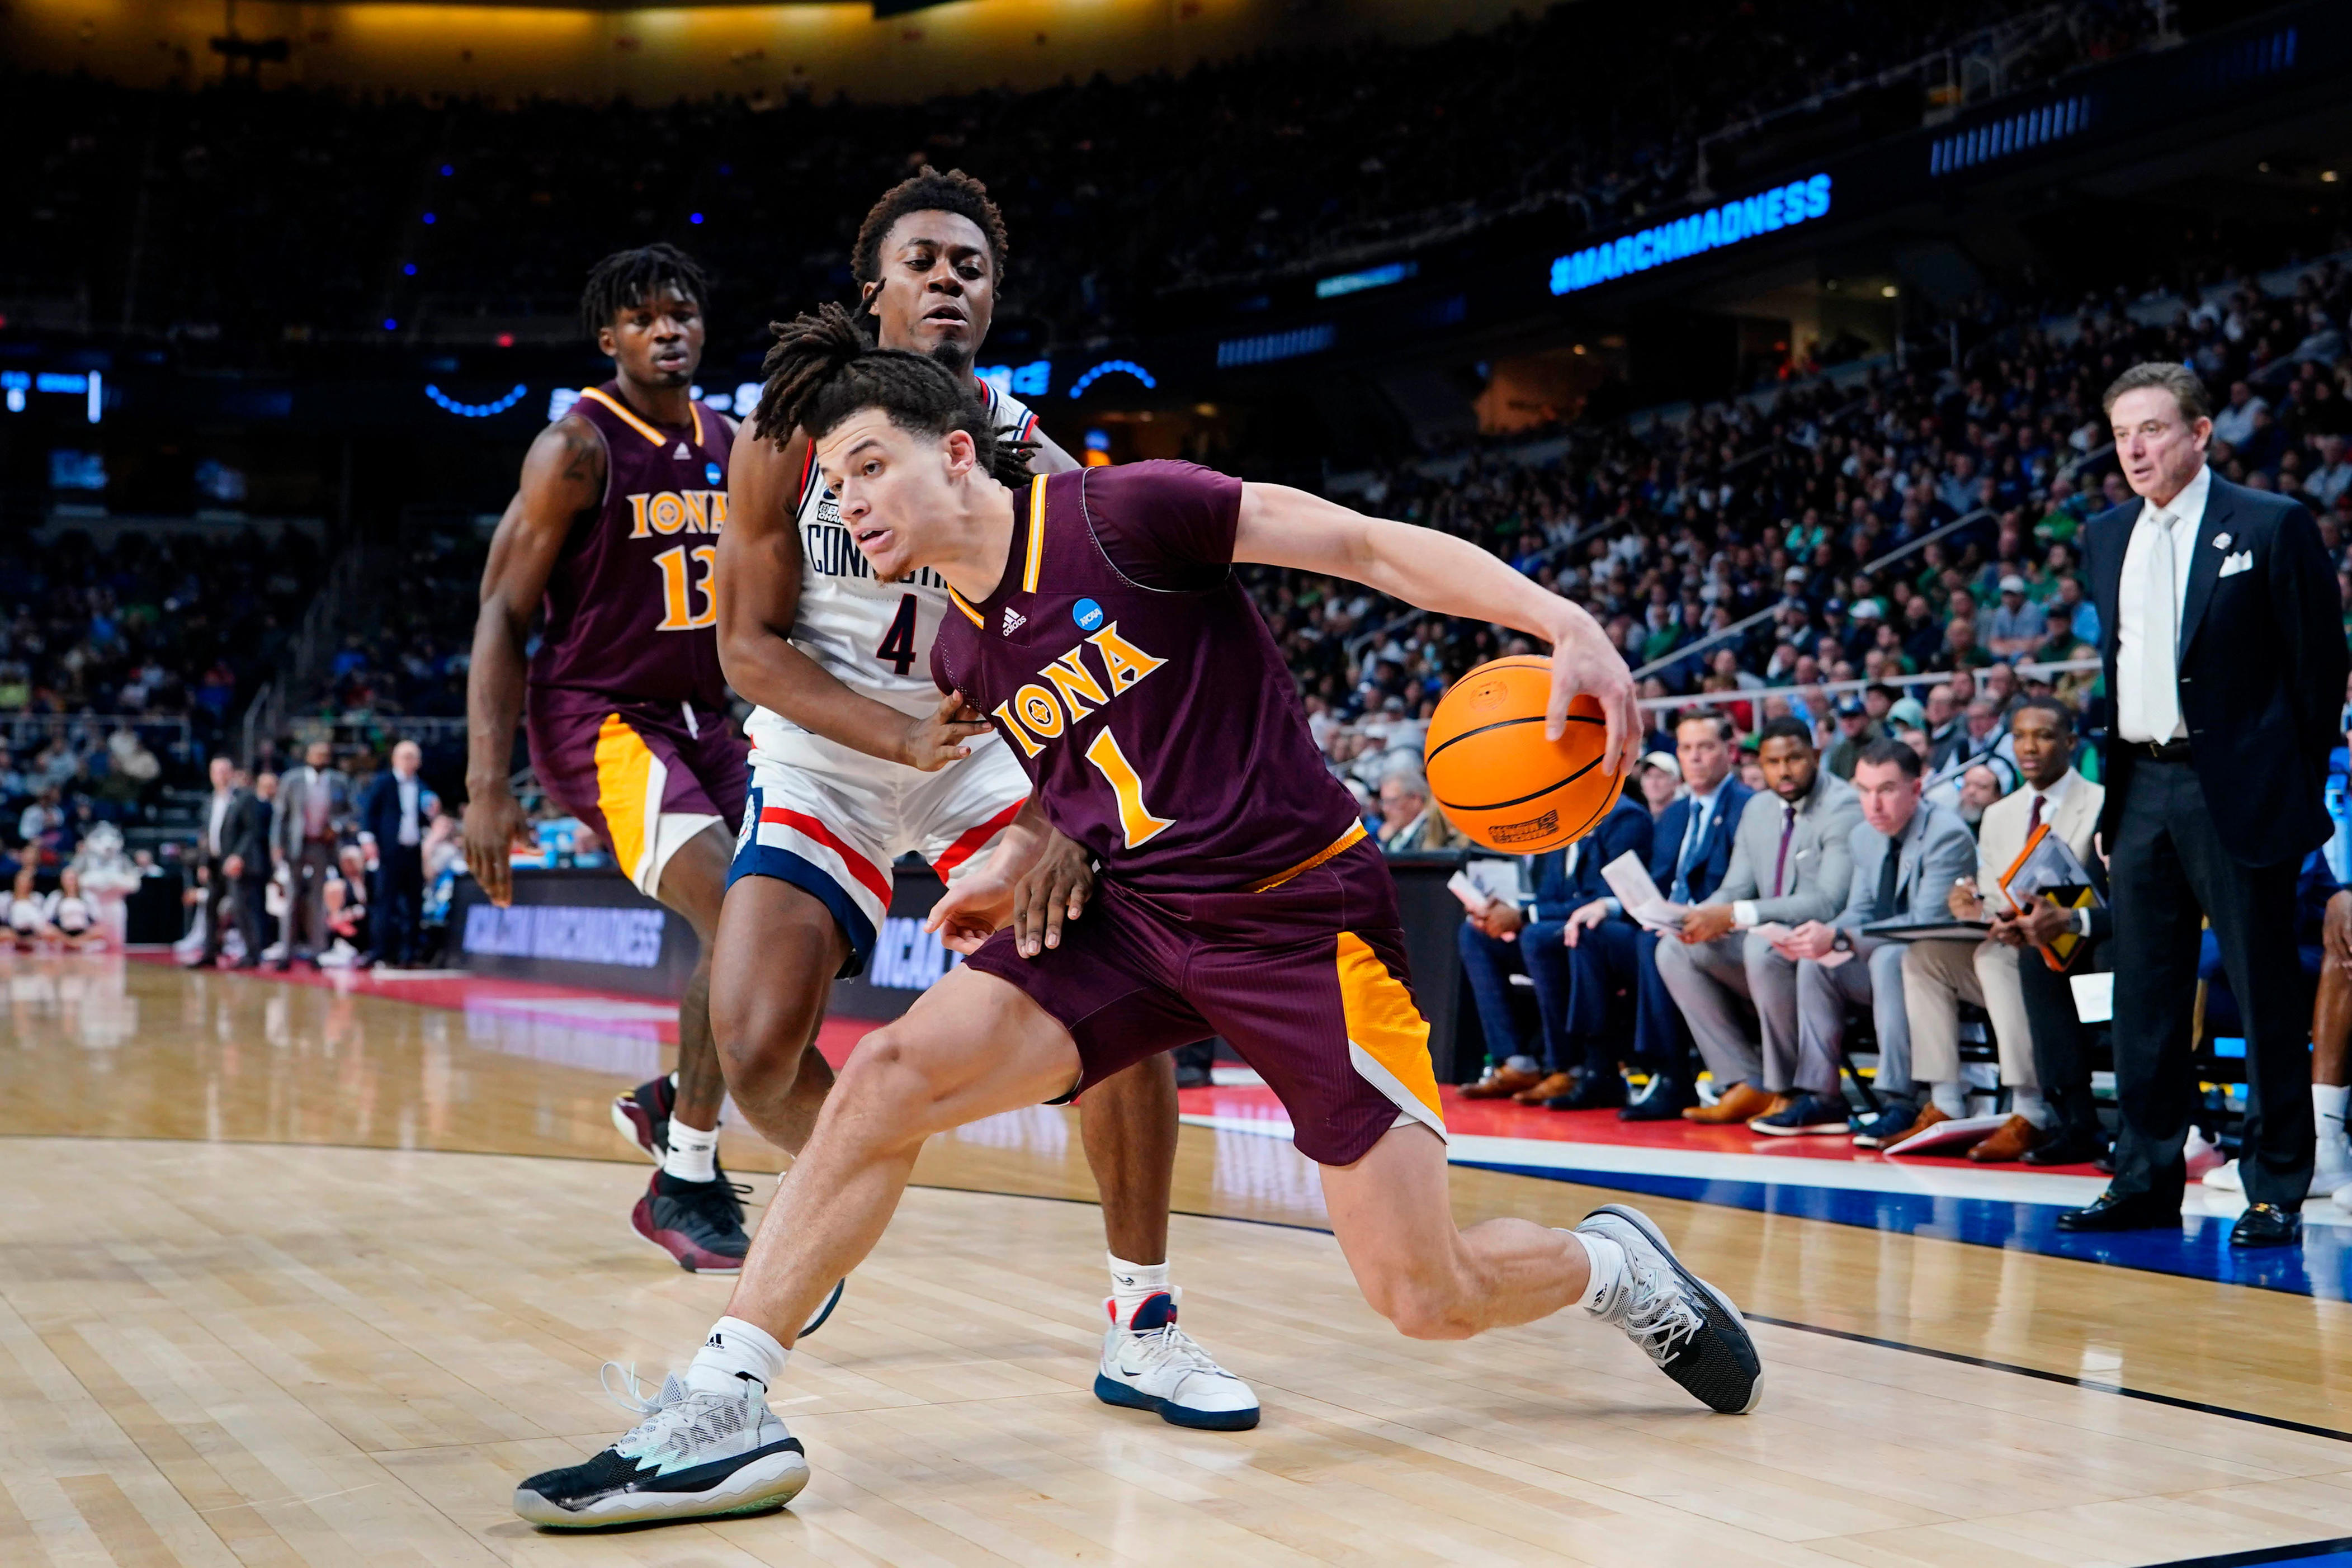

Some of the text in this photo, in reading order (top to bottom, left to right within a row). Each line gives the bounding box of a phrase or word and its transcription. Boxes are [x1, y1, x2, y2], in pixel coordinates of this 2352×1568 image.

[1550, 173, 1831, 296] #MARCHMADNESS
[652, 544, 716, 631] 13
[1003, 615, 1027, 636] adidas
[1079, 608, 1102, 627] NCAA
[876, 593, 917, 675] 4
[991, 620, 1169, 759] IONA
[1084, 725, 1177, 850] 1
